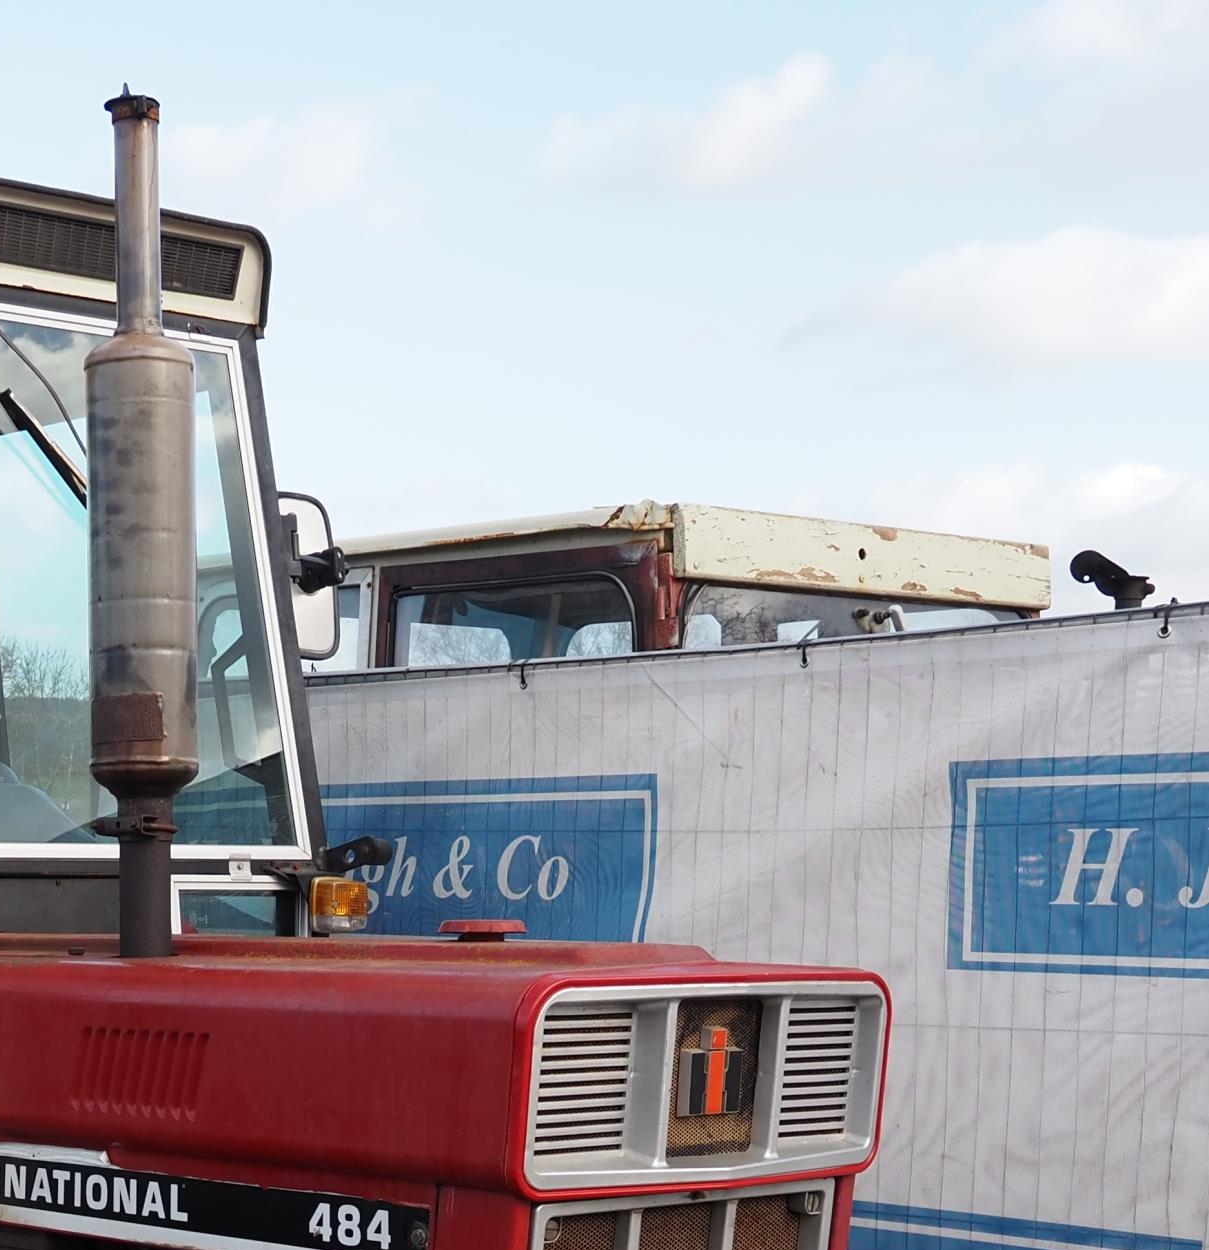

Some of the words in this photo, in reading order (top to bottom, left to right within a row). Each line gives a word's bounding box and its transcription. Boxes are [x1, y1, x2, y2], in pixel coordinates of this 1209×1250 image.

[433, 835, 474, 900] &
[497, 834, 570, 901] Co
[1048, 828, 1144, 908] H.
[308, 1202, 392, 1250] 484
